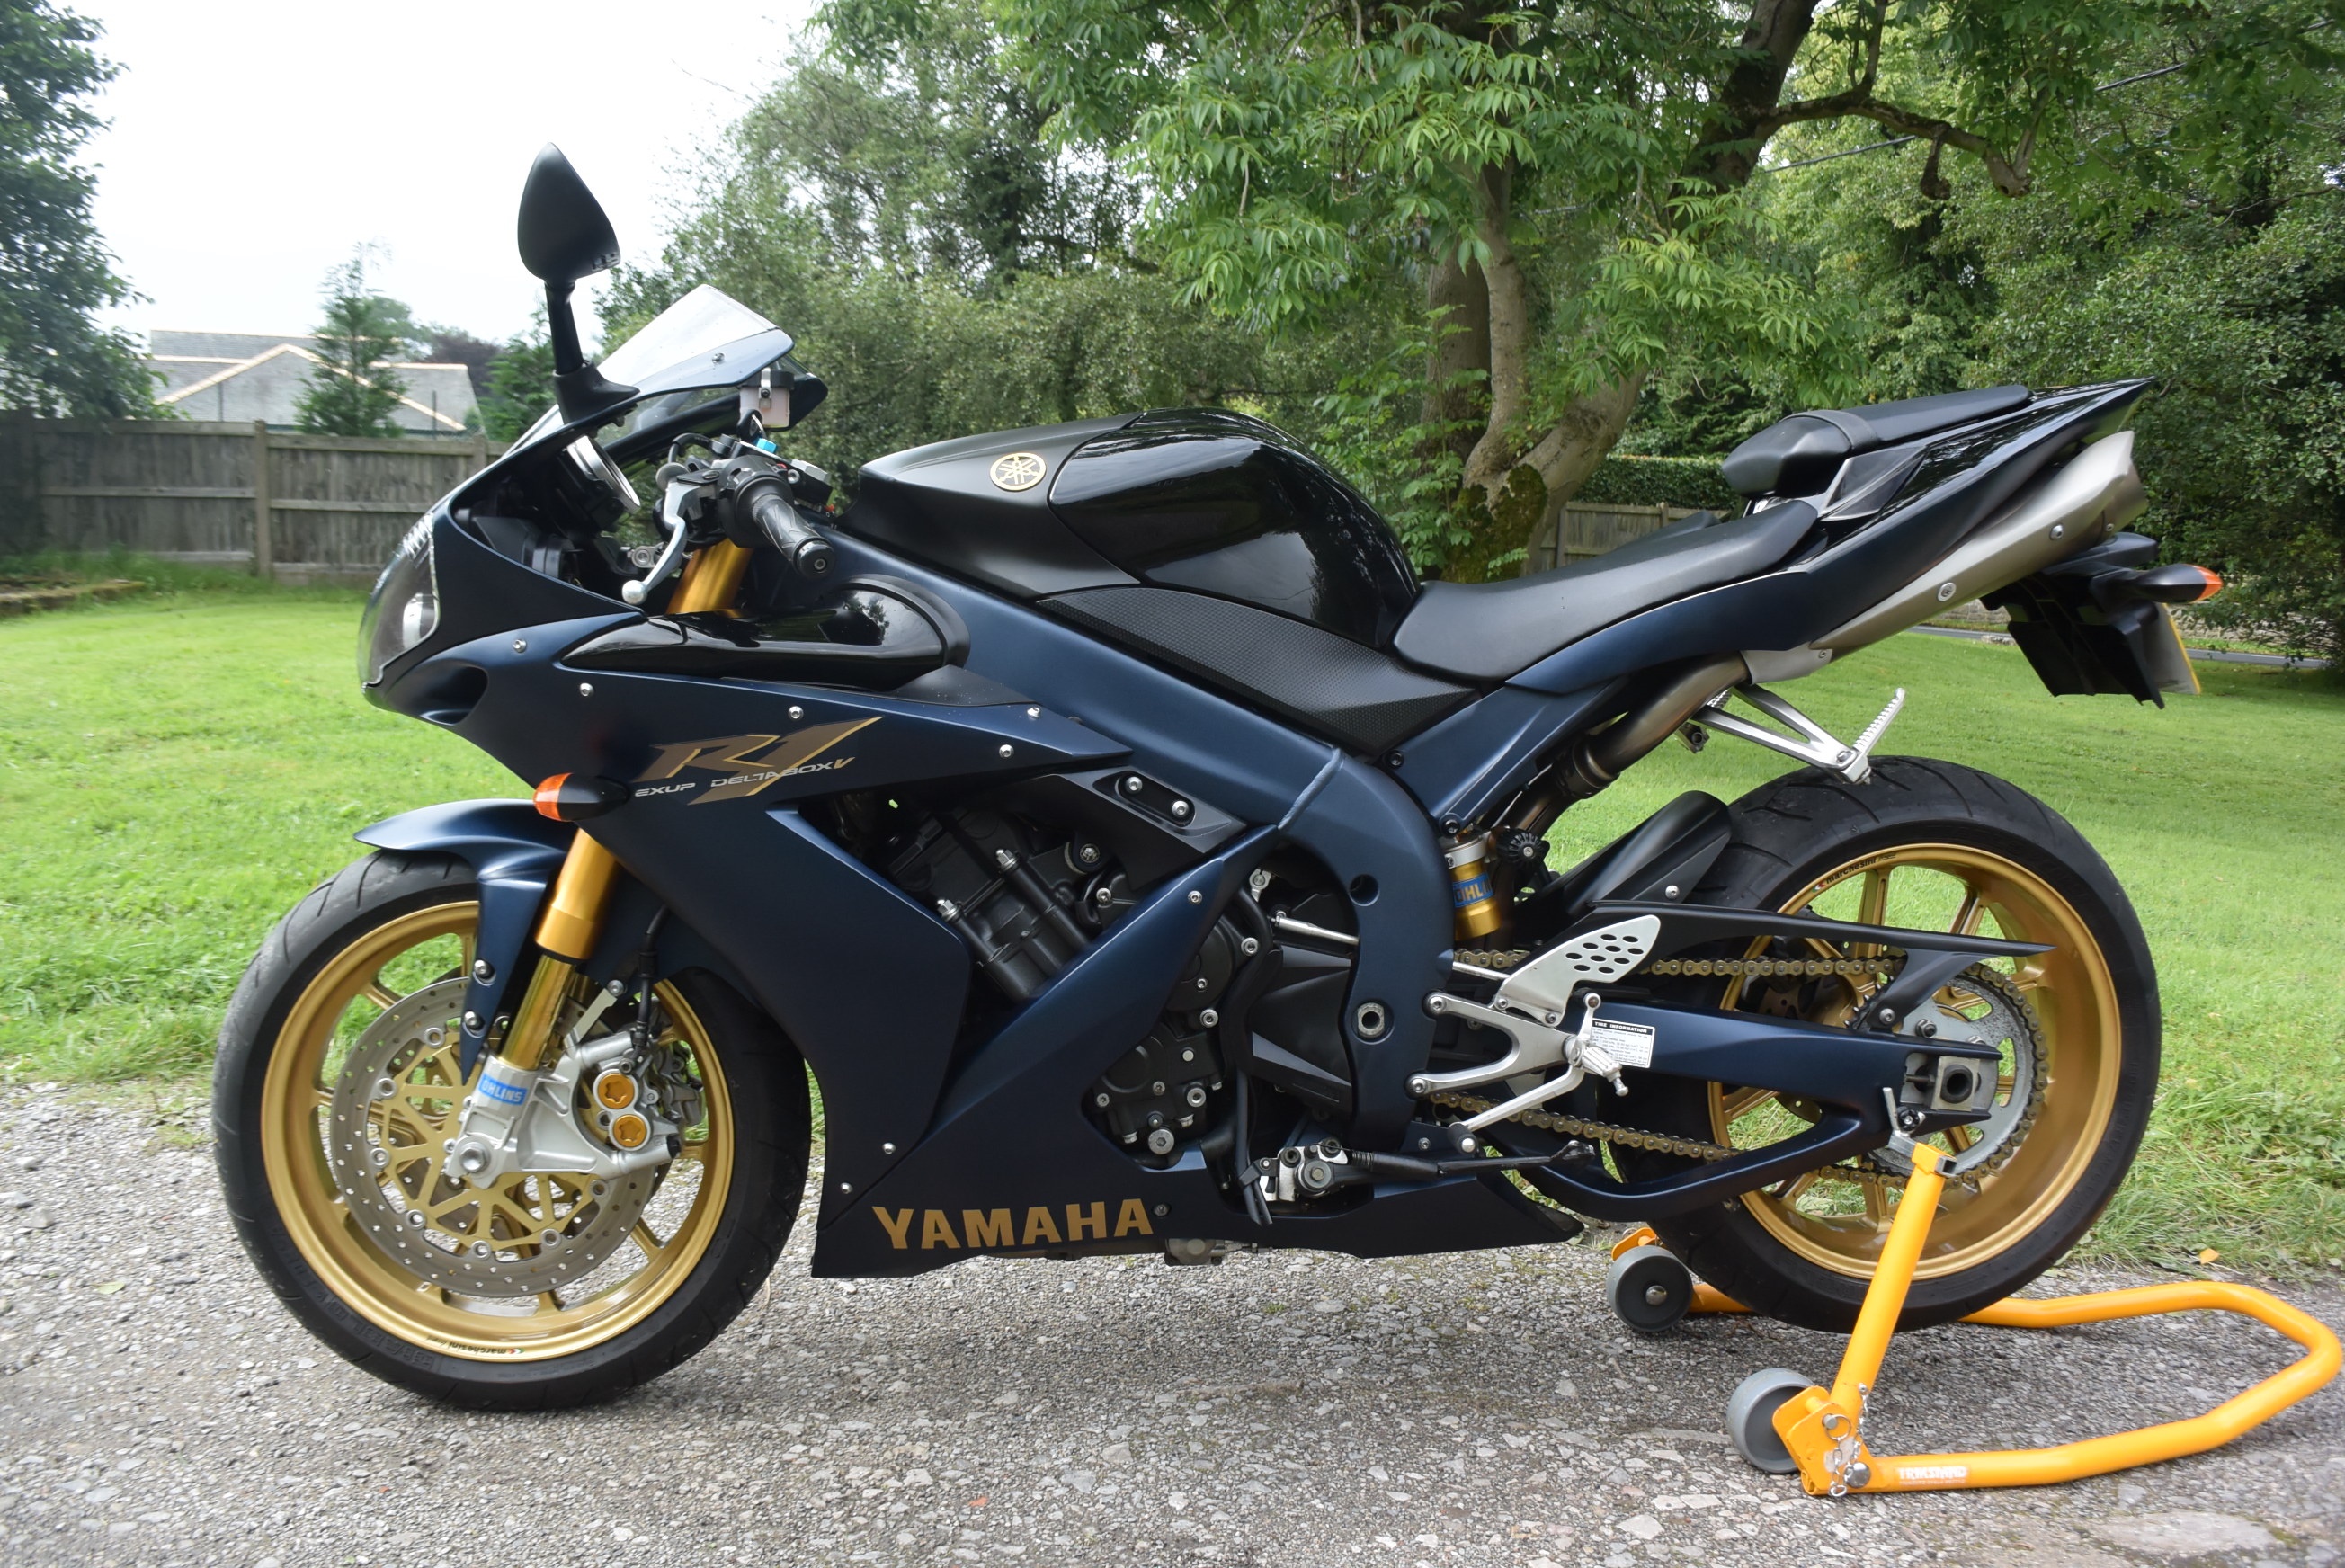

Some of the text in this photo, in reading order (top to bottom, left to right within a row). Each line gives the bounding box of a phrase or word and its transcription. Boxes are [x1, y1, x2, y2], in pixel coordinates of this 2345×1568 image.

[635, 782, 696, 797] EXUP
[1826, 858, 1876, 884] marchesini
[1609, 1023, 1648, 1033] INFORMATION
[871, 1198, 1154, 1249] YAMAHA
[448, 1341, 507, 1356] marchesini
